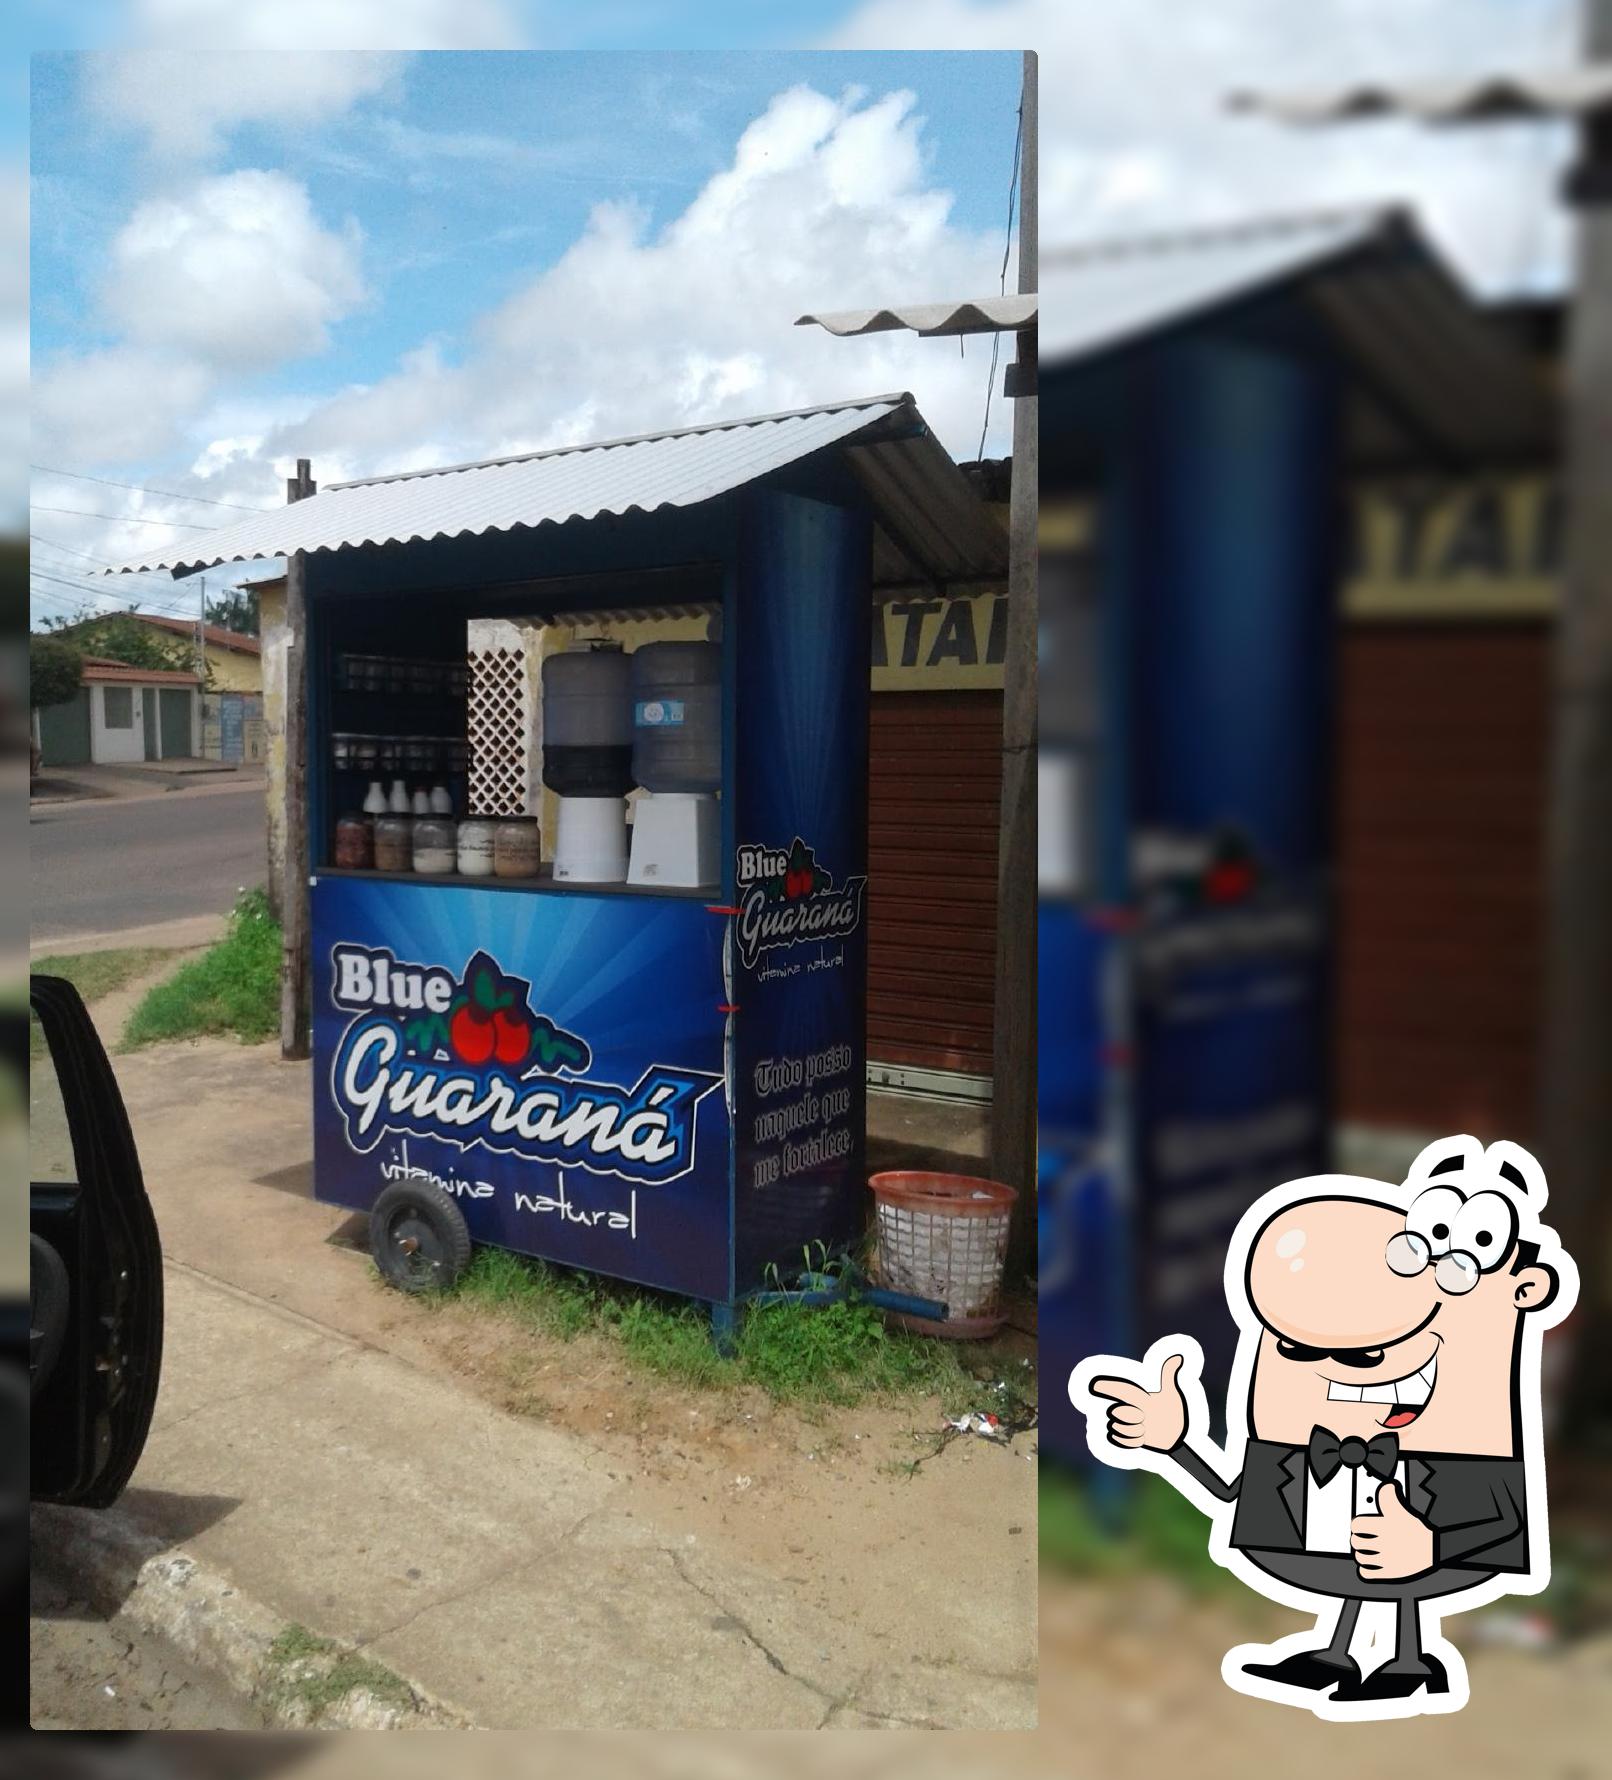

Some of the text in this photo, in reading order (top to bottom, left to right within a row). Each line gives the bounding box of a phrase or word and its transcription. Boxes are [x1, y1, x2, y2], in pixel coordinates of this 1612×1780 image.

[741, 852, 788, 880] Blue
[742, 888, 855, 956] Guaraná
[340, 953, 452, 1012] Blue
[757, 944, 844, 983] vitamina natural
[345, 1024, 678, 1163] Guaraná
[755, 1045, 852, 1097] Tudo posso
[754, 1087, 850, 1144] naquele que
[380, 1139, 637, 1240] vitamina natural
[753, 1154, 782, 1188] me
